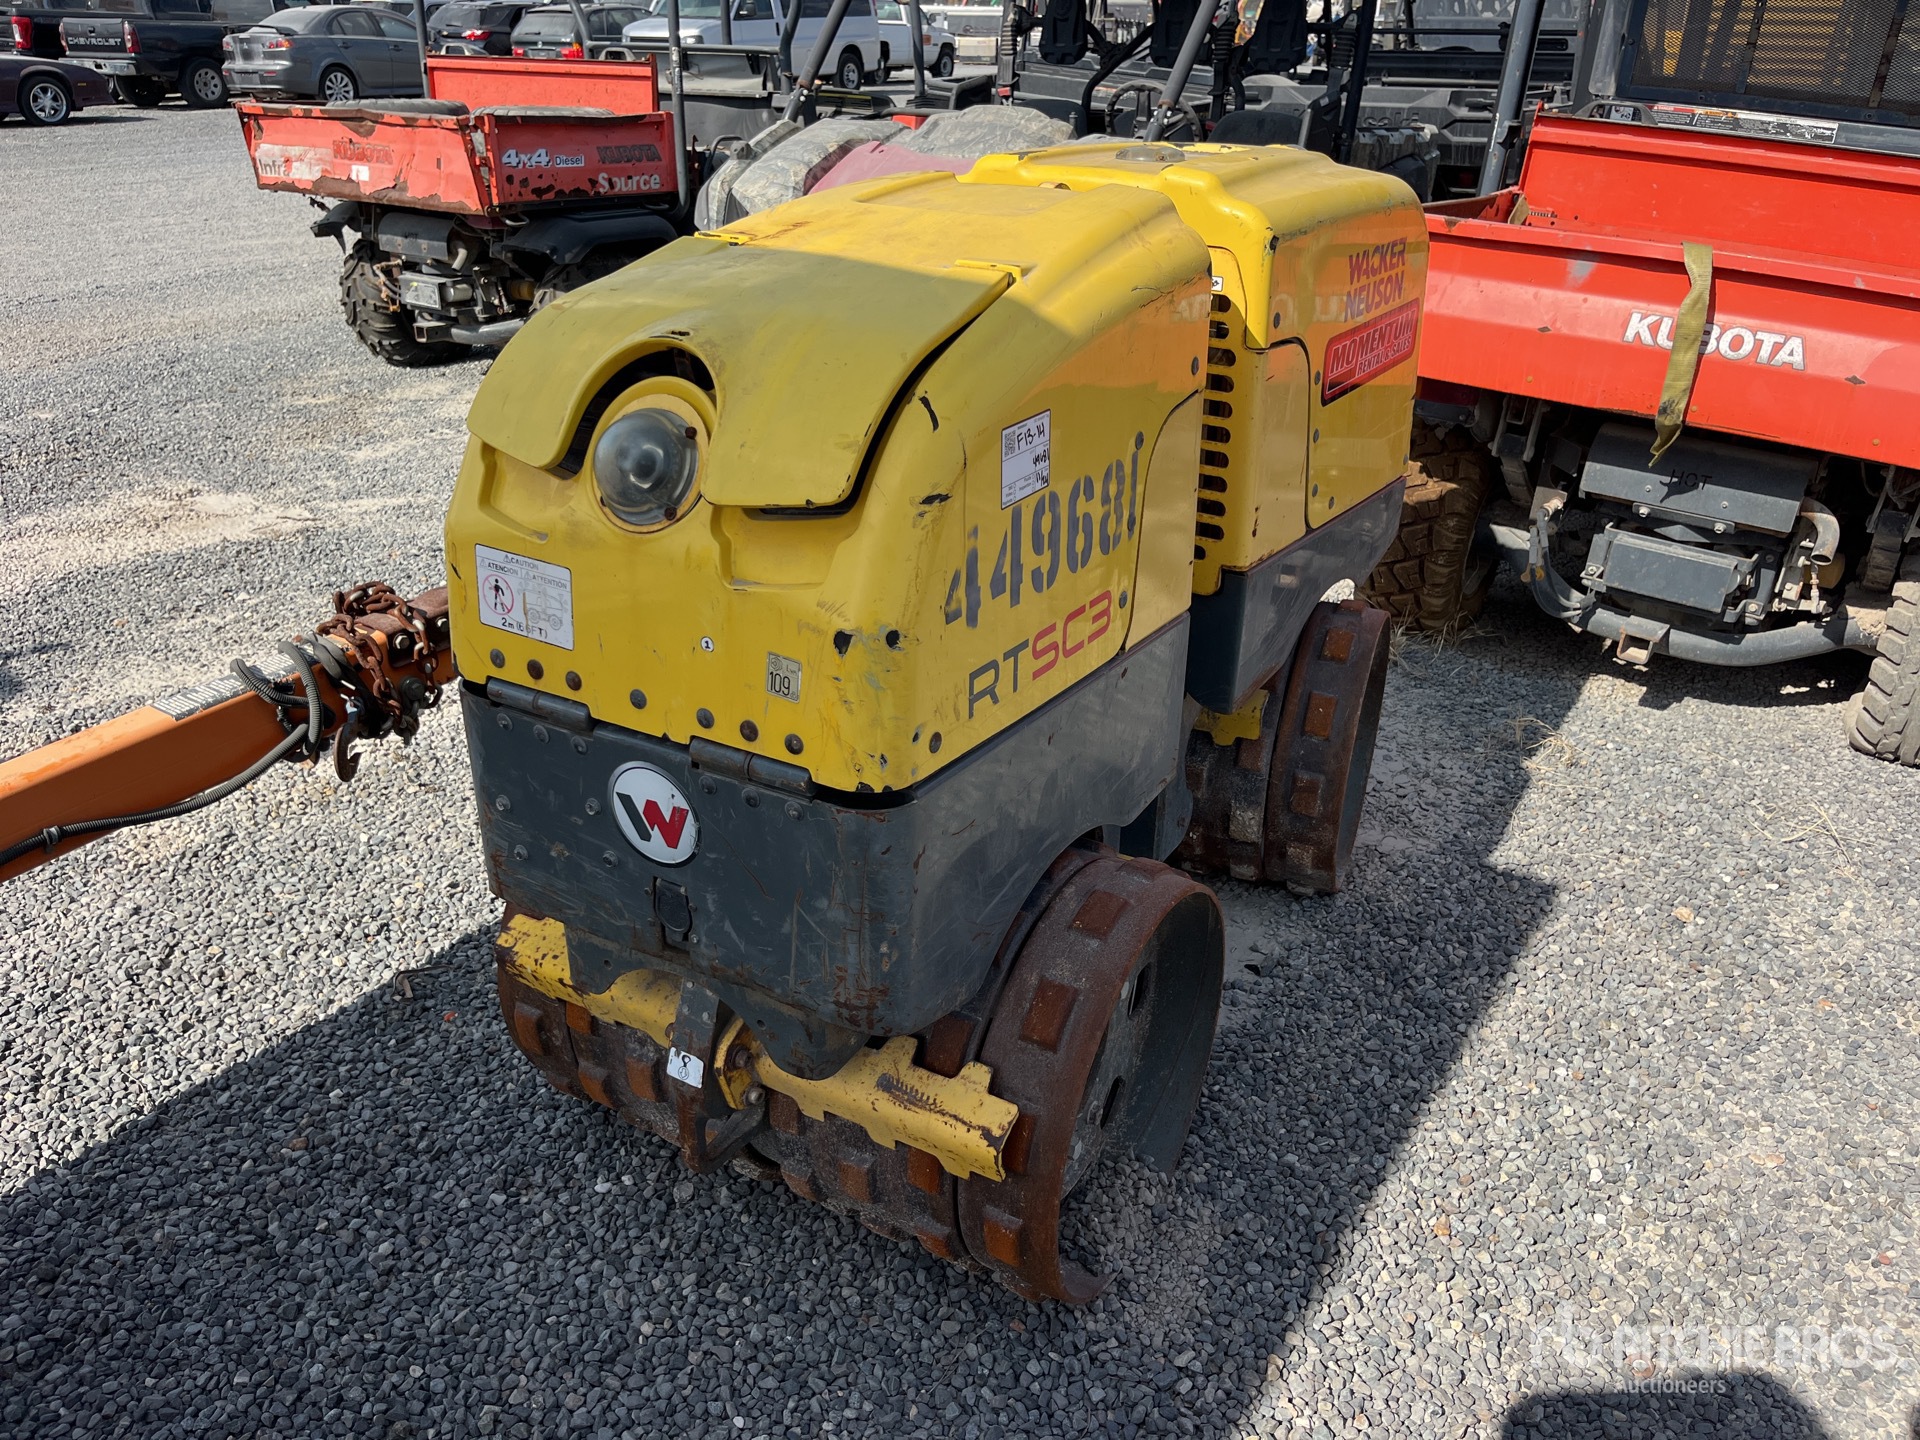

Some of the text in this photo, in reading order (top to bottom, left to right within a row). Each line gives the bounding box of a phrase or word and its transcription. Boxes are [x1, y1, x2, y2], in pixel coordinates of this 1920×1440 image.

[67, 37, 121, 46] CHEVROLET
[332, 139, 394, 165] KUBOTA
[555, 154, 584, 166] Diesel
[596, 143, 662, 164] KUBOTA
[597, 171, 660, 193] Source
[1348, 237, 1407, 285] WACKER
[1343, 270, 1405, 323] NEUSON
[1329, 308, 1417, 376] MOMENTUM
[1622, 310, 1806, 371] KUBOTA
[1356, 349, 1384, 378] RENTAL
[1391, 335, 1413, 357] SALES
[1668, 469, 1713, 490] HOT
[510, 557, 540, 570] CAUTION
[532, 574, 568, 590] ATTENTION
[769, 671, 791, 696] 109
